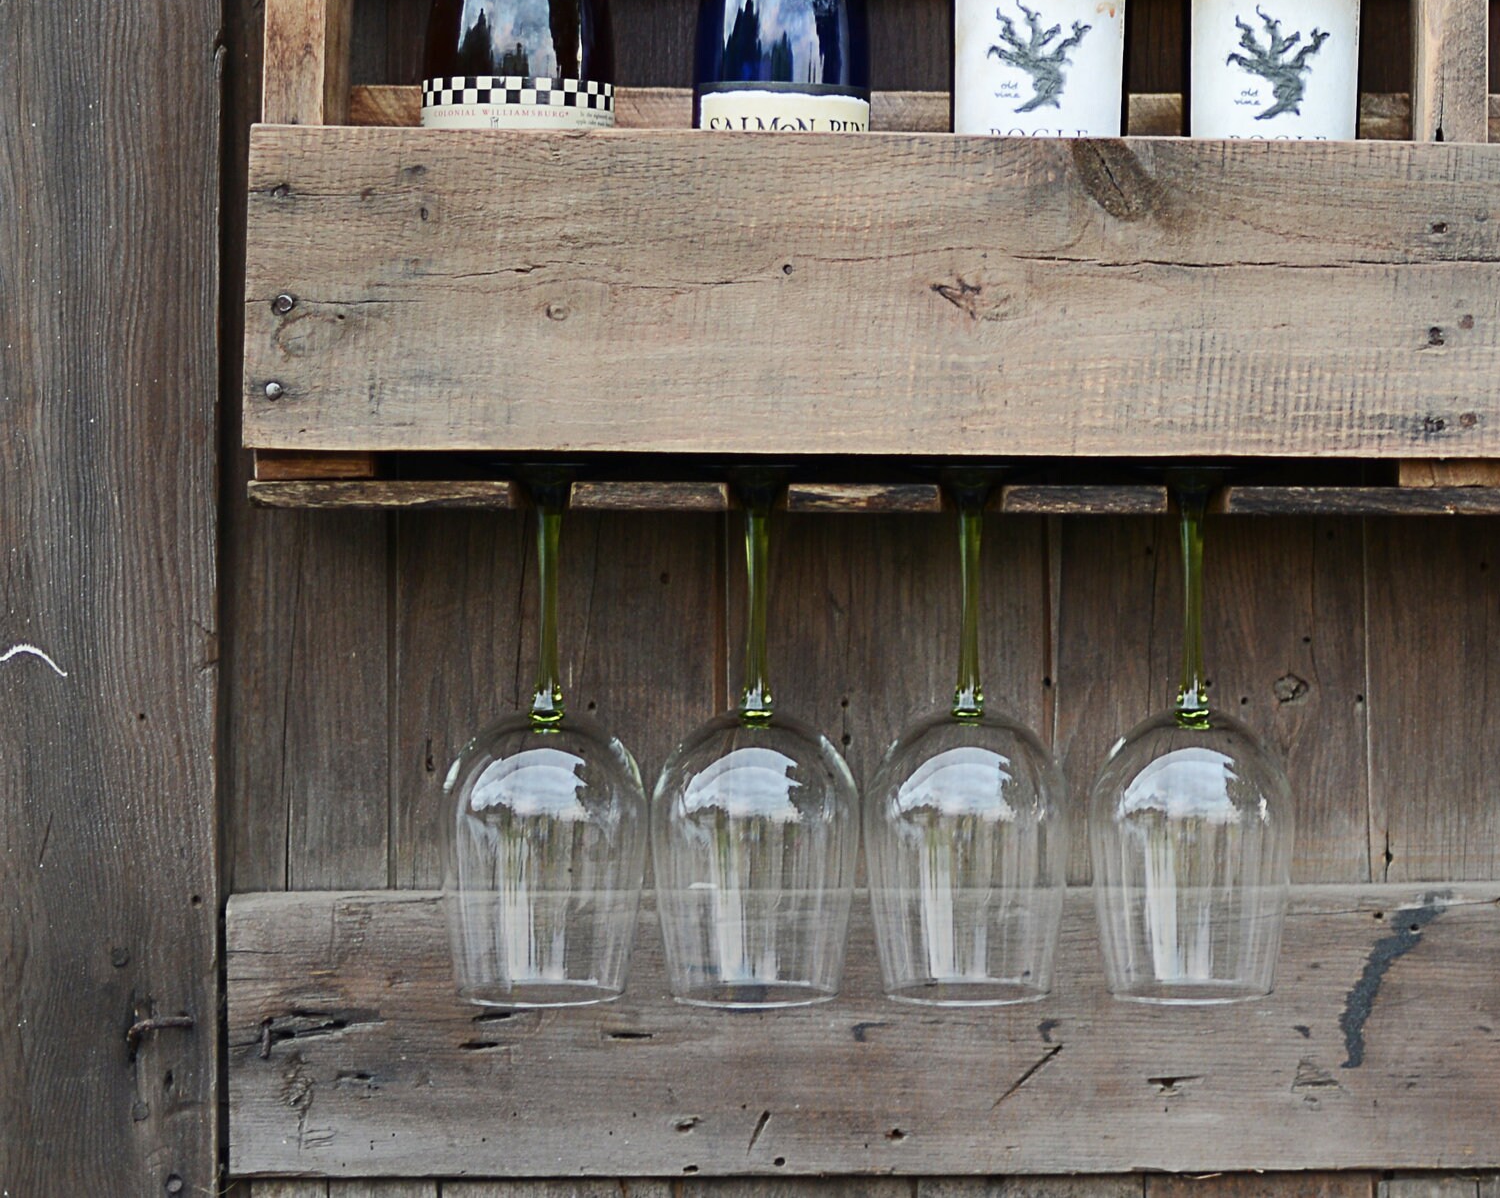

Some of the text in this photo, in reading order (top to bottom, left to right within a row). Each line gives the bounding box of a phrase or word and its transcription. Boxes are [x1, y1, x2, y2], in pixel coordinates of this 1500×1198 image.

[1000, 81, 1018, 89] old
[1240, 88, 1258, 96] old
[434, 109, 476, 118] COLONIAL
